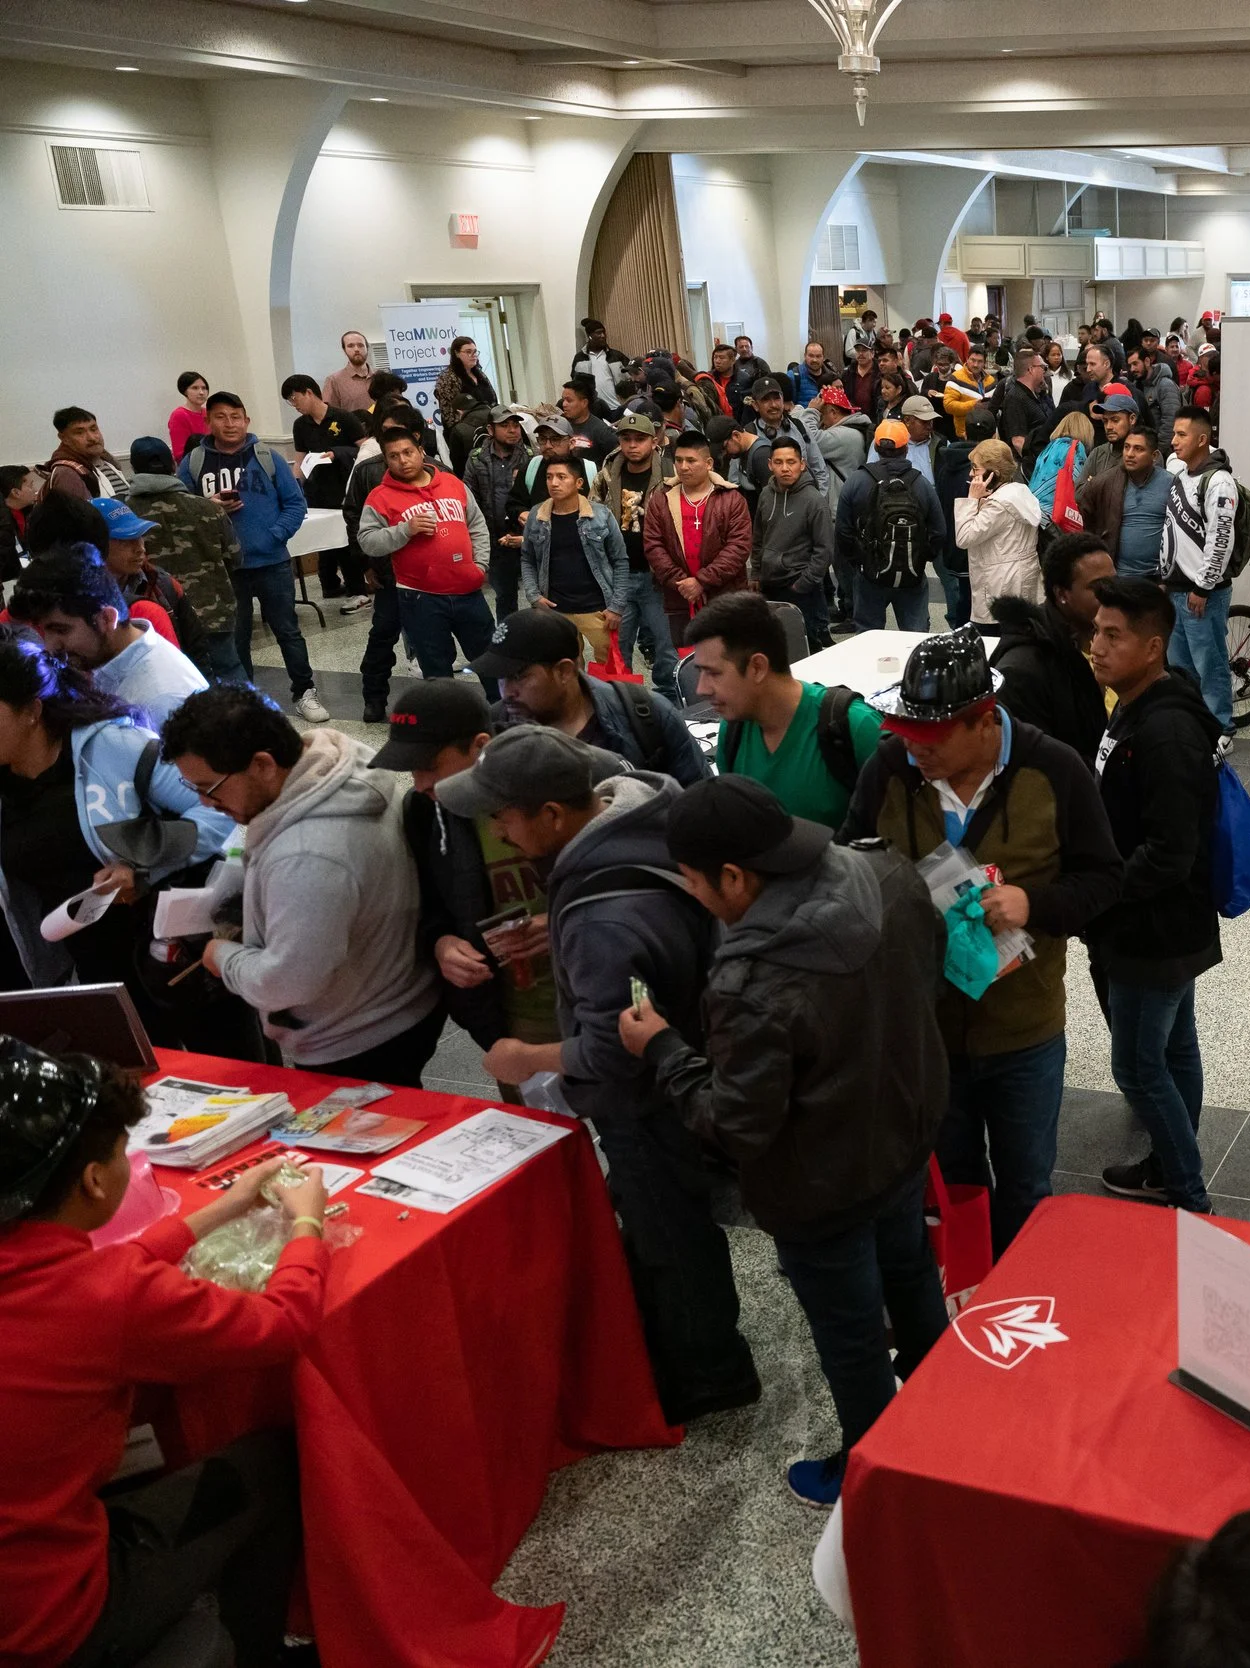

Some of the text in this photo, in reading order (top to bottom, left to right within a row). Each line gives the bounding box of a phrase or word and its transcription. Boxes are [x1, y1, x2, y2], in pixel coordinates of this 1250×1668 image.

[389, 326, 458, 342] TeaMWork
[394, 346, 437, 363] Project
[1214, 515, 1232, 550] CHICAGO
